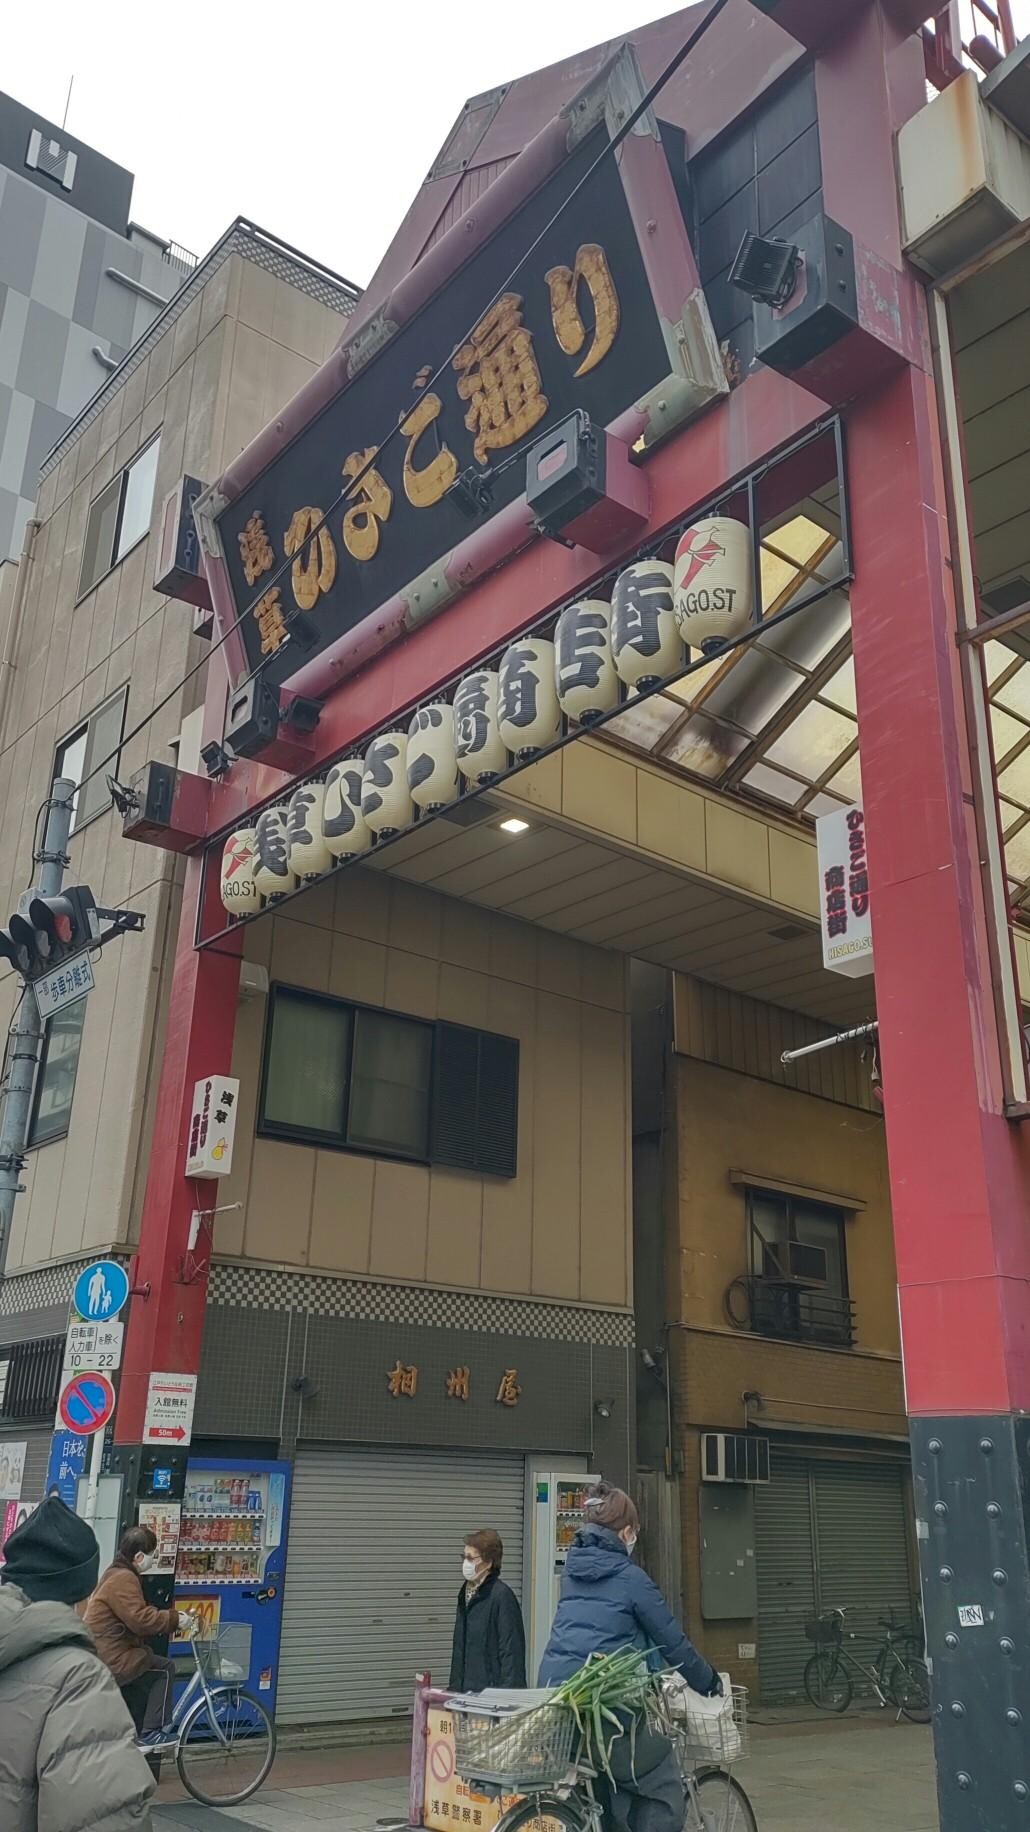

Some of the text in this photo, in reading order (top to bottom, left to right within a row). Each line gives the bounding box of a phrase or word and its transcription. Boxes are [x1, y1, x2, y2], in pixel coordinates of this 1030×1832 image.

[824, 865, 848, 939] 商店街
[70, 1326, 96, 1339] 自転車
[98, 1333, 120, 1346] を除く
[68, 1340, 95, 1353] 人力車
[70, 1355, 82, 1367] 10
[98, 1355, 114, 1367] 22
[386, 1360, 523, 1407] 相州屋
[153, 1397, 189, 1409] 入館無料
[431, 1799, 482, 1826] 浅草警察署
